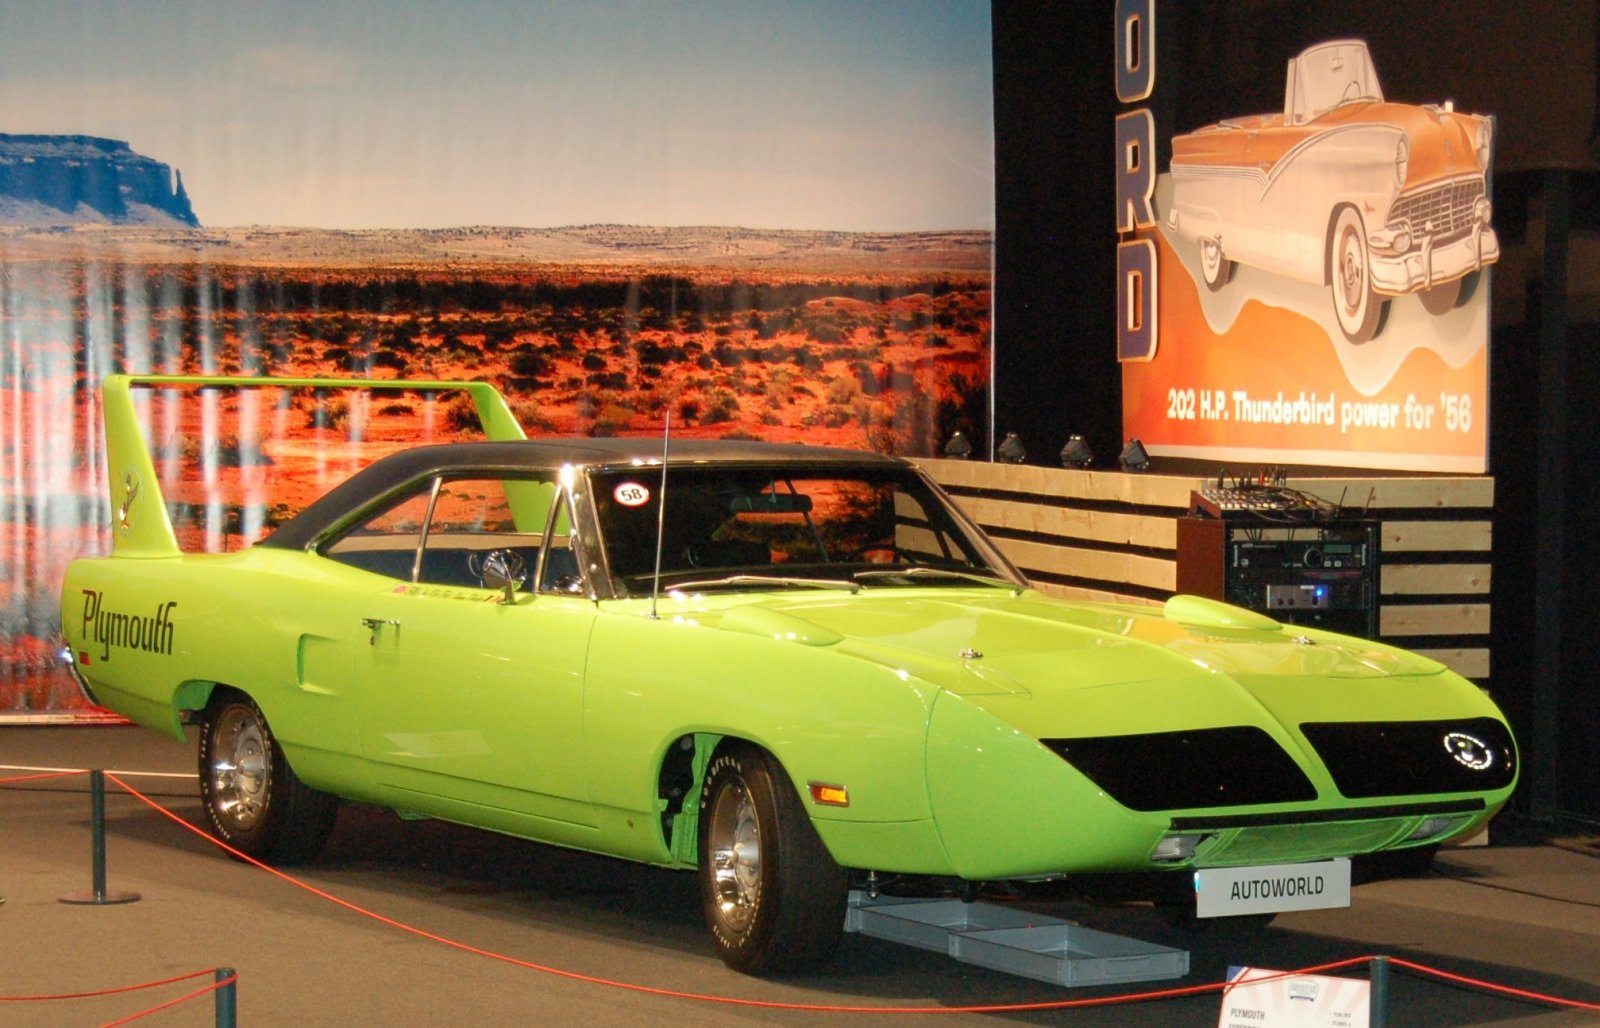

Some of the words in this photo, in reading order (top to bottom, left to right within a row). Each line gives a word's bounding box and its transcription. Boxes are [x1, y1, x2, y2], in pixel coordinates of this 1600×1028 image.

[1167, 388, 1196, 420] 202
[1200, 389, 1229, 421] H.P.
[1232, 390, 1335, 425] Thunderbird
[1341, 401, 1399, 434] power
[1404, 393, 1435, 430] for
[1440, 391, 1472, 433] '56
[620, 488, 642, 501] 58
[82, 589, 177, 662] Plymouth
[1231, 876, 1324, 900] AUTOWORLD
[1230, 1007, 1265, 1021] PLYMOUTH
